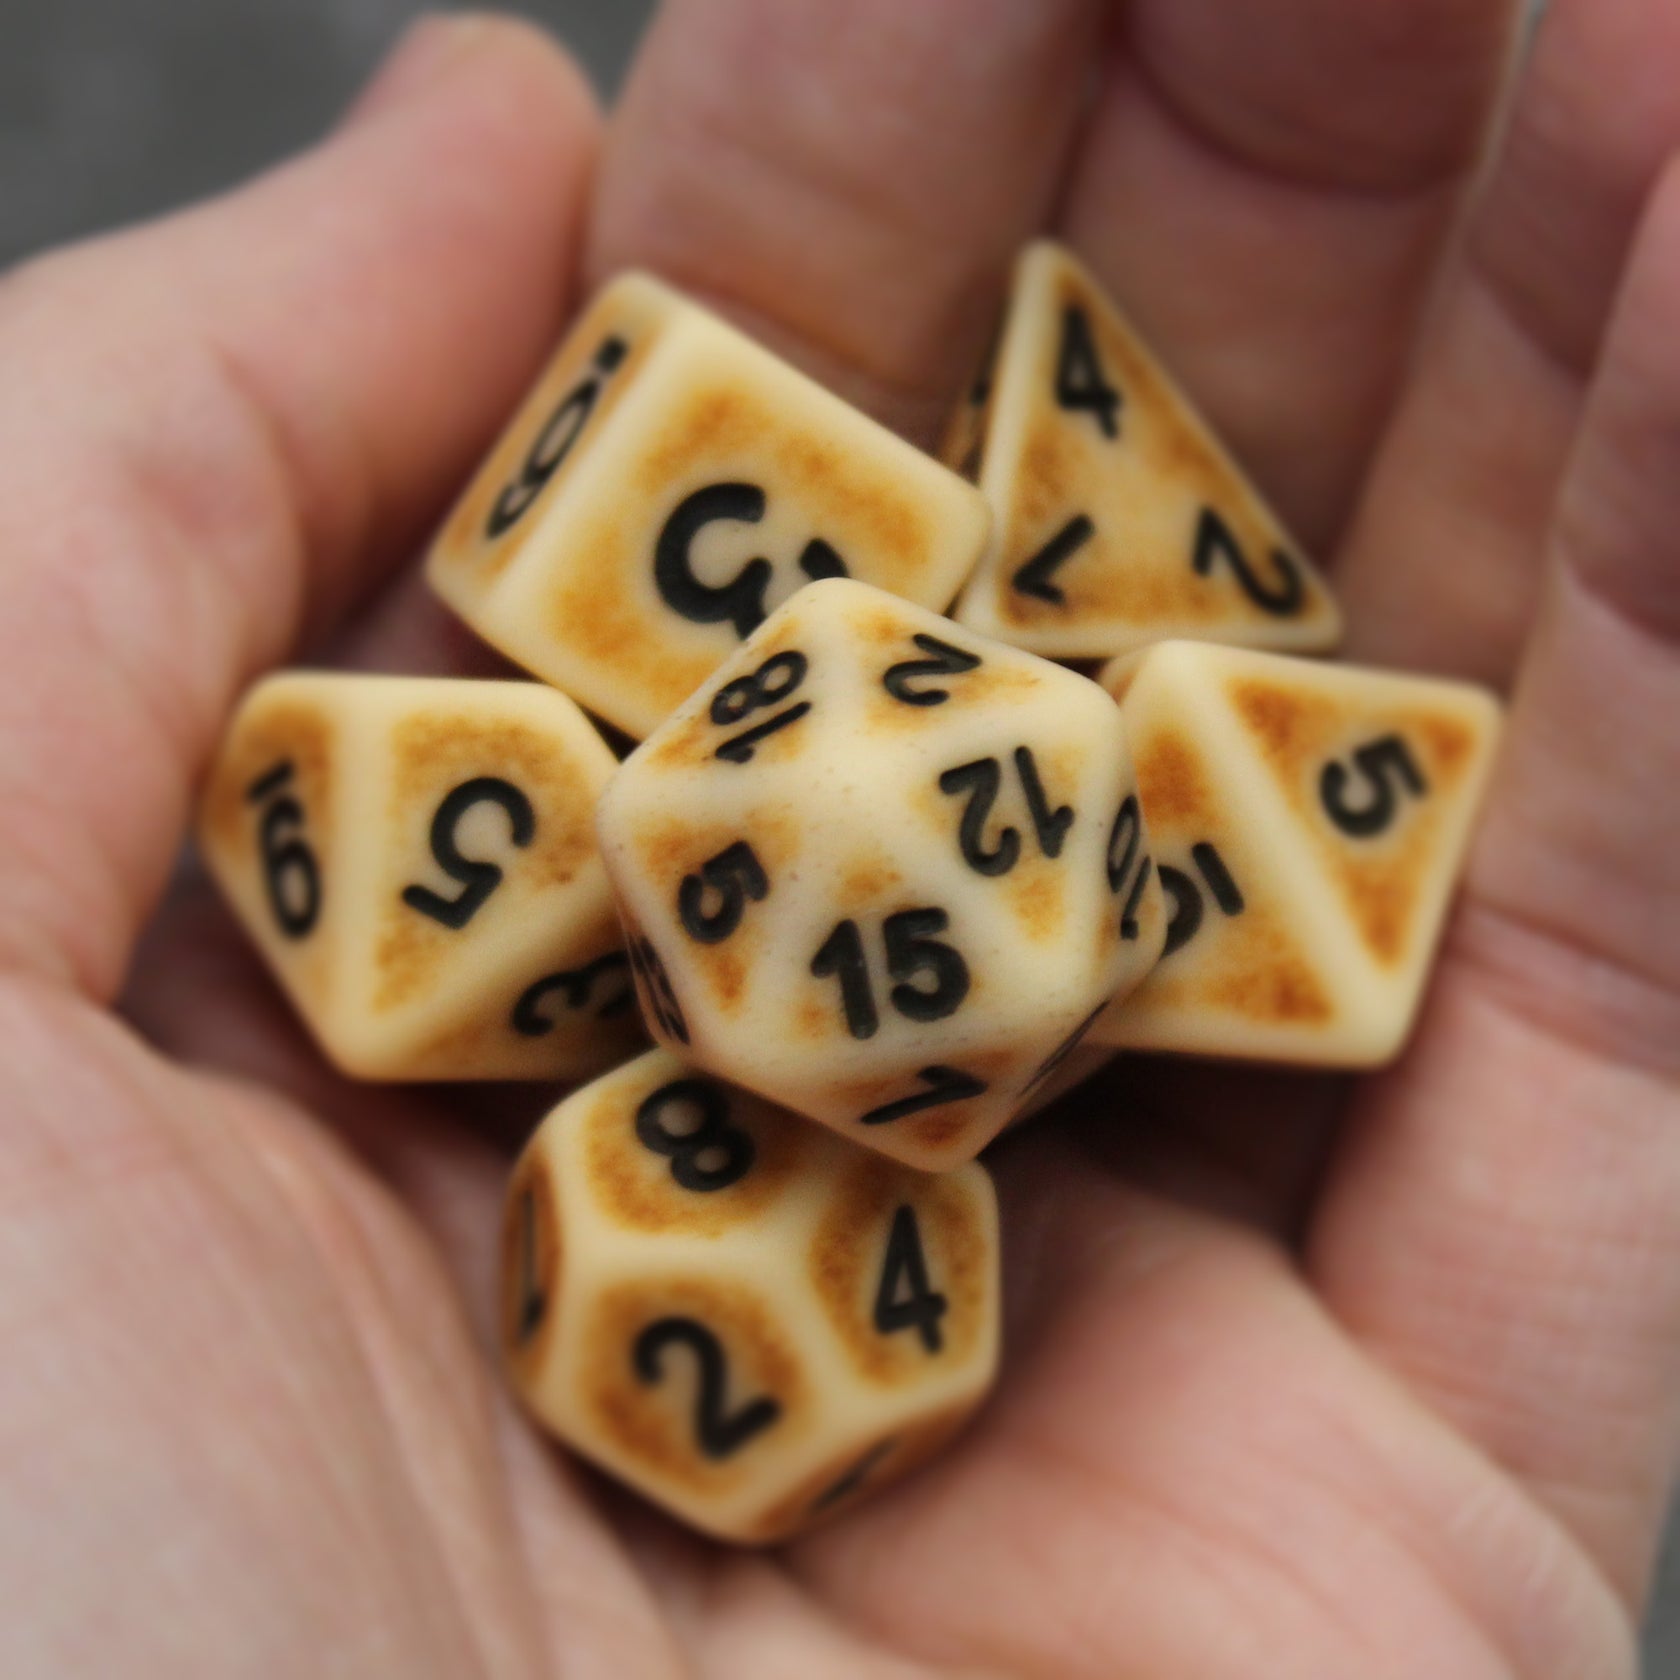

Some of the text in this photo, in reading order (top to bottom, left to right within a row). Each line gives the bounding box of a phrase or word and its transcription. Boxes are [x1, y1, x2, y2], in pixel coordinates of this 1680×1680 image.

[1053, 303, 1122, 440] 4
[1192, 506, 1308, 619] 2
[709, 649, 812, 765] 18
[882, 632, 983, 707] 2
[937, 745, 1076, 879] 12
[1319, 733, 1430, 840] 5
[401, 775, 537, 930] 5
[676, 839, 771, 946] 5
[808, 905, 972, 1042] 15
[635, 1077, 757, 1192] 8
[871, 1203, 948, 1354] 4
[632, 1314, 782, 1460] 2
